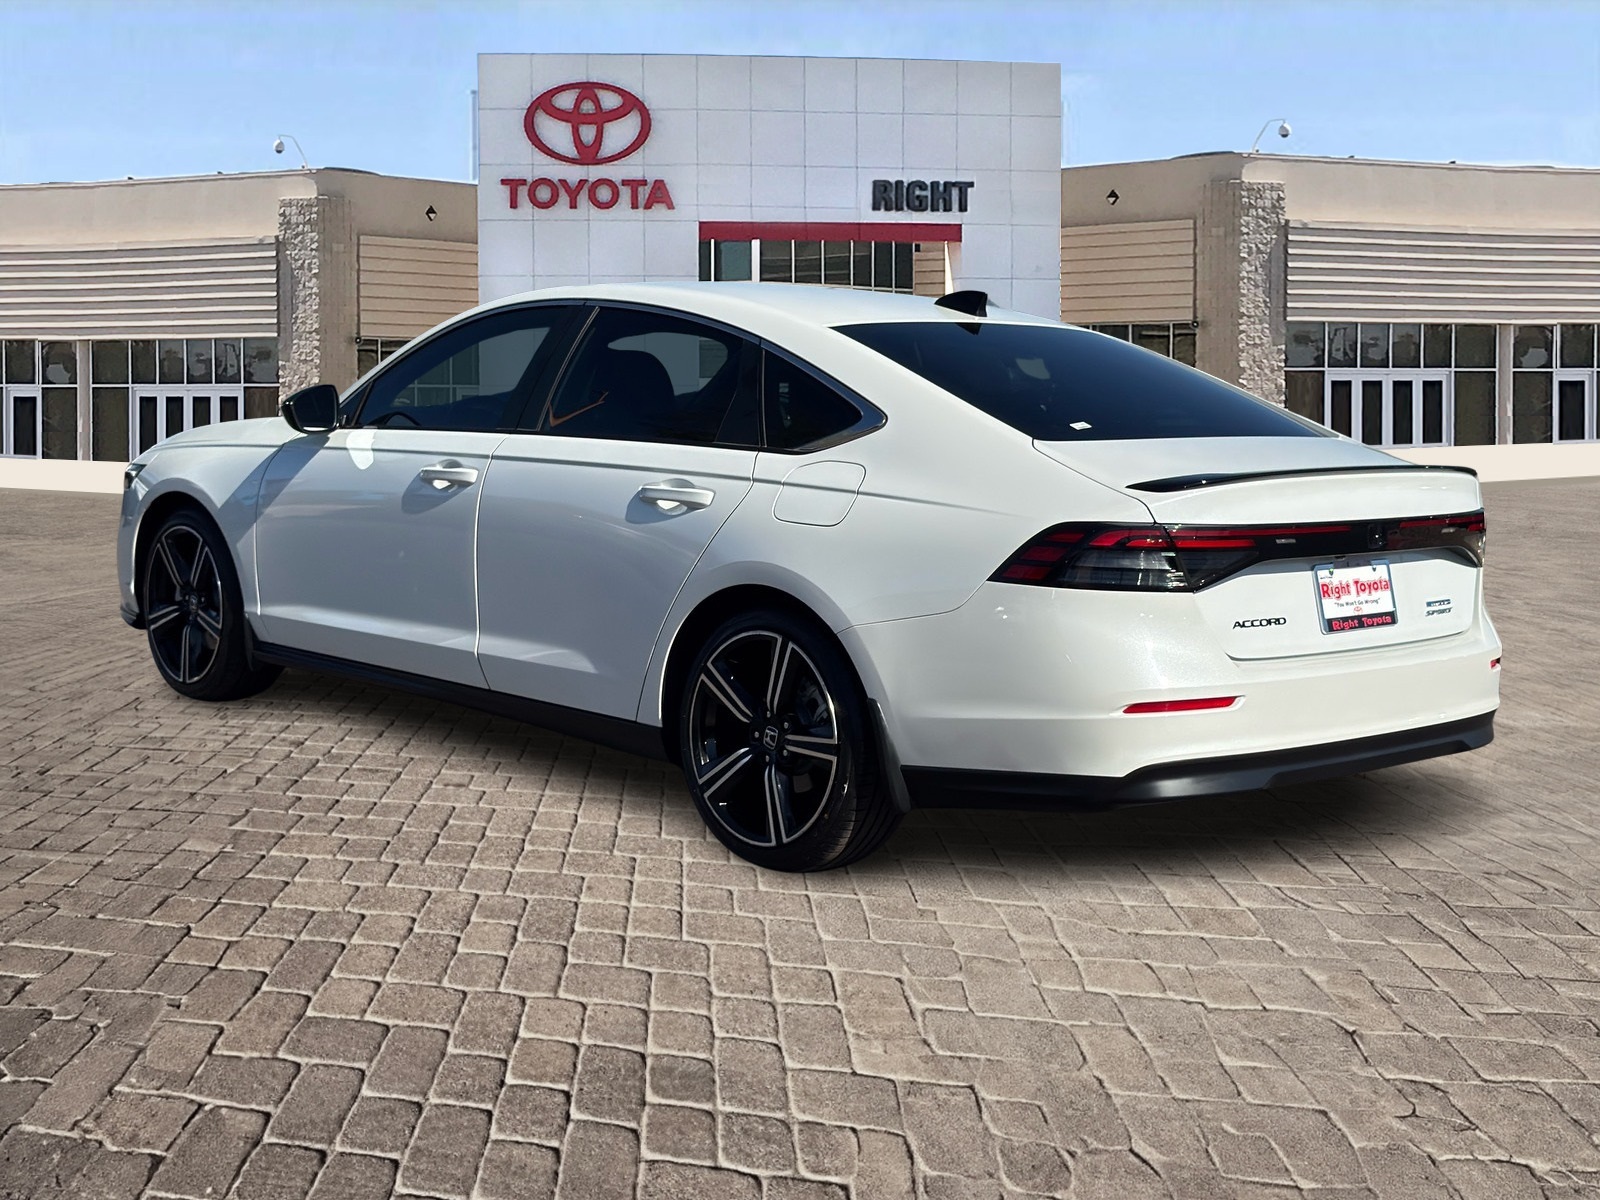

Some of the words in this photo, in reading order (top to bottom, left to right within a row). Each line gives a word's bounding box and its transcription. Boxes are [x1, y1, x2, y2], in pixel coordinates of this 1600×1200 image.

[500, 178, 675, 210] TOYOTA
[871, 179, 975, 213] RIGHT
[1320, 581, 1351, 600] Right
[1353, 577, 1390, 597] Toyota
[1232, 617, 1287, 629] ACCORD
[1332, 619, 1359, 631] Right
[1362, 615, 1392, 627] Toyota
